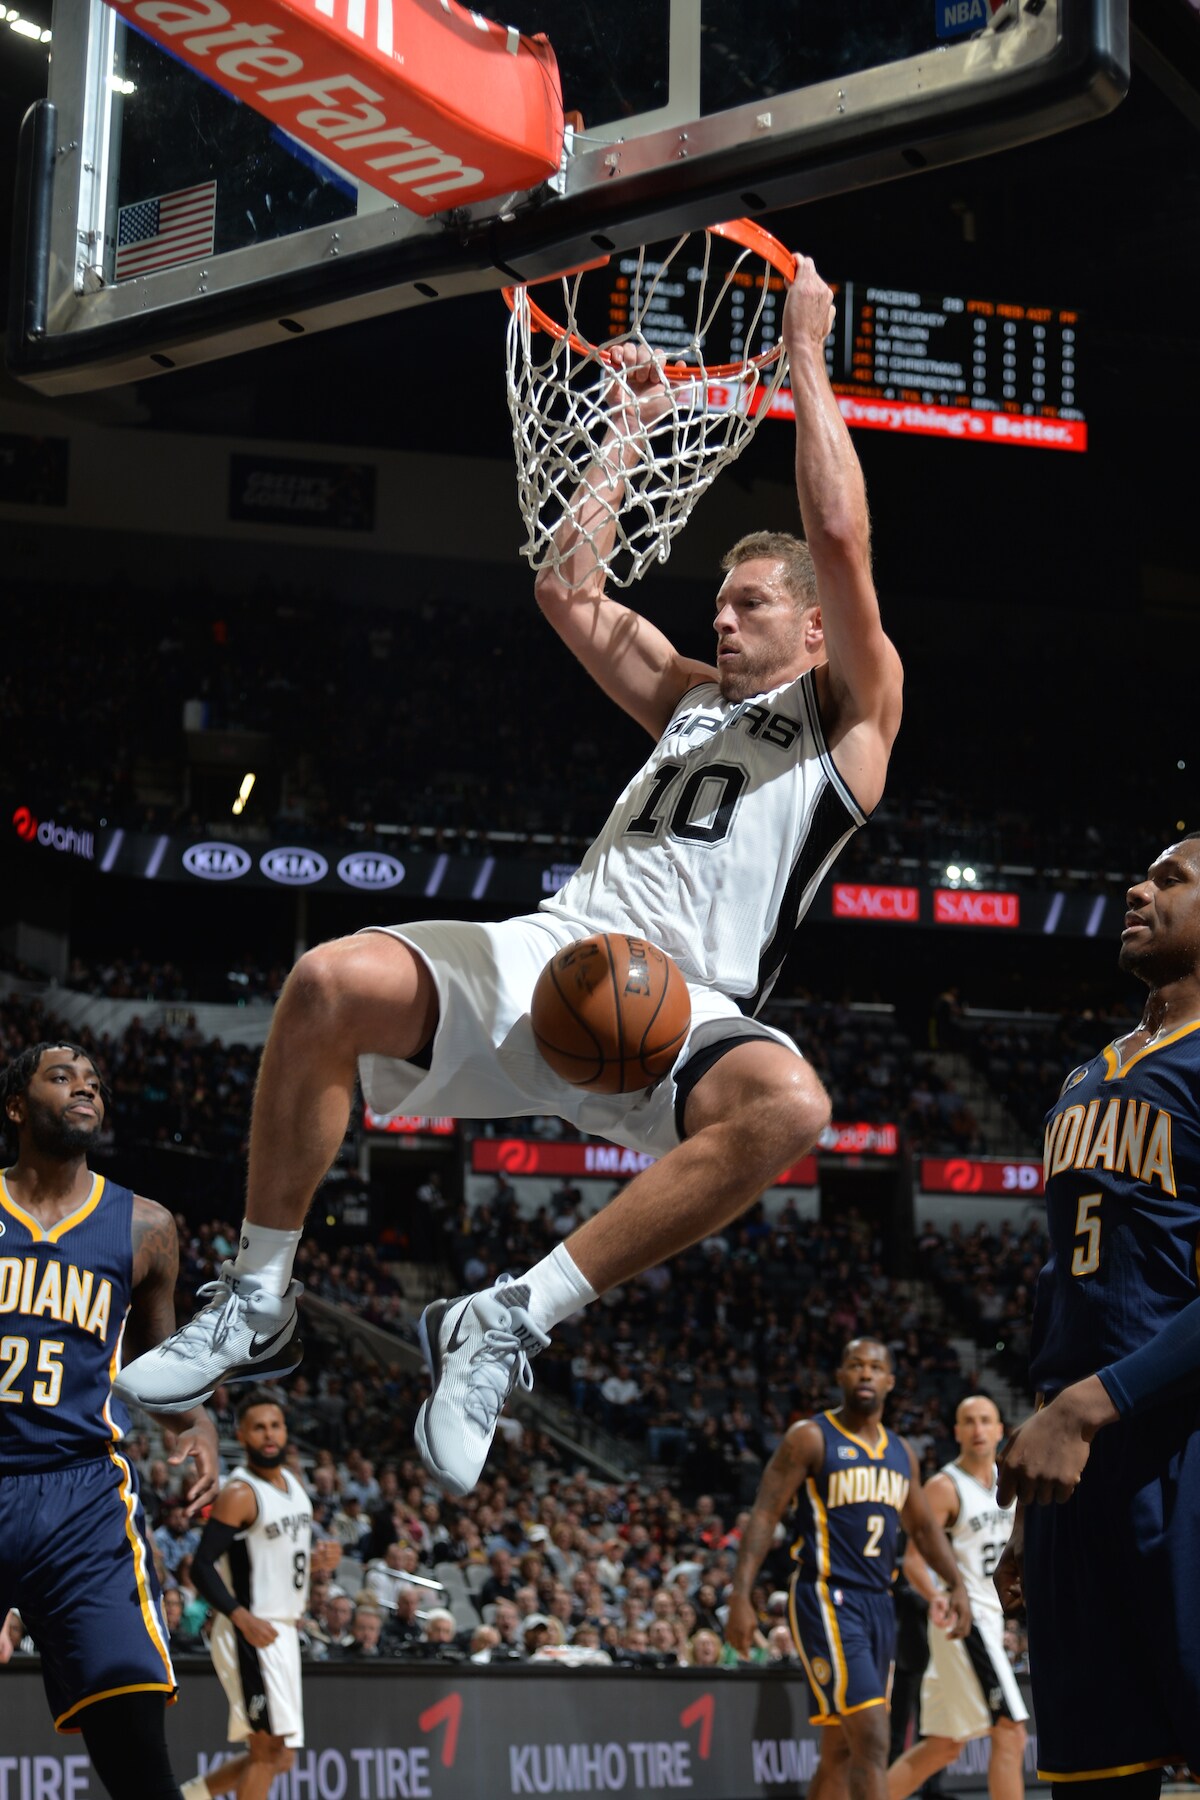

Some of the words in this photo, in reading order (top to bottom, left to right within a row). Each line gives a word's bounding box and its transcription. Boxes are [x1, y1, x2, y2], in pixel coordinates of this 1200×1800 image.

[944, 0, 983, 28] NBA
[622, 759, 751, 850] 10
[37, 819, 94, 860] dahill
[836, 885, 916, 918] SACU
[936, 892, 1017, 925] SACU
[1002, 1165, 1038, 1190] 3D
[1071, 1193, 1103, 1276] 5
[0, 1336, 64, 1406] 25
[863, 1514, 885, 1557] 2
[292, 1551, 308, 1591] 8
[351, 1747, 432, 1799] TIRE
[509, 1741, 627, 1793] KUMHO
[628, 1742, 693, 1788] TIRE
